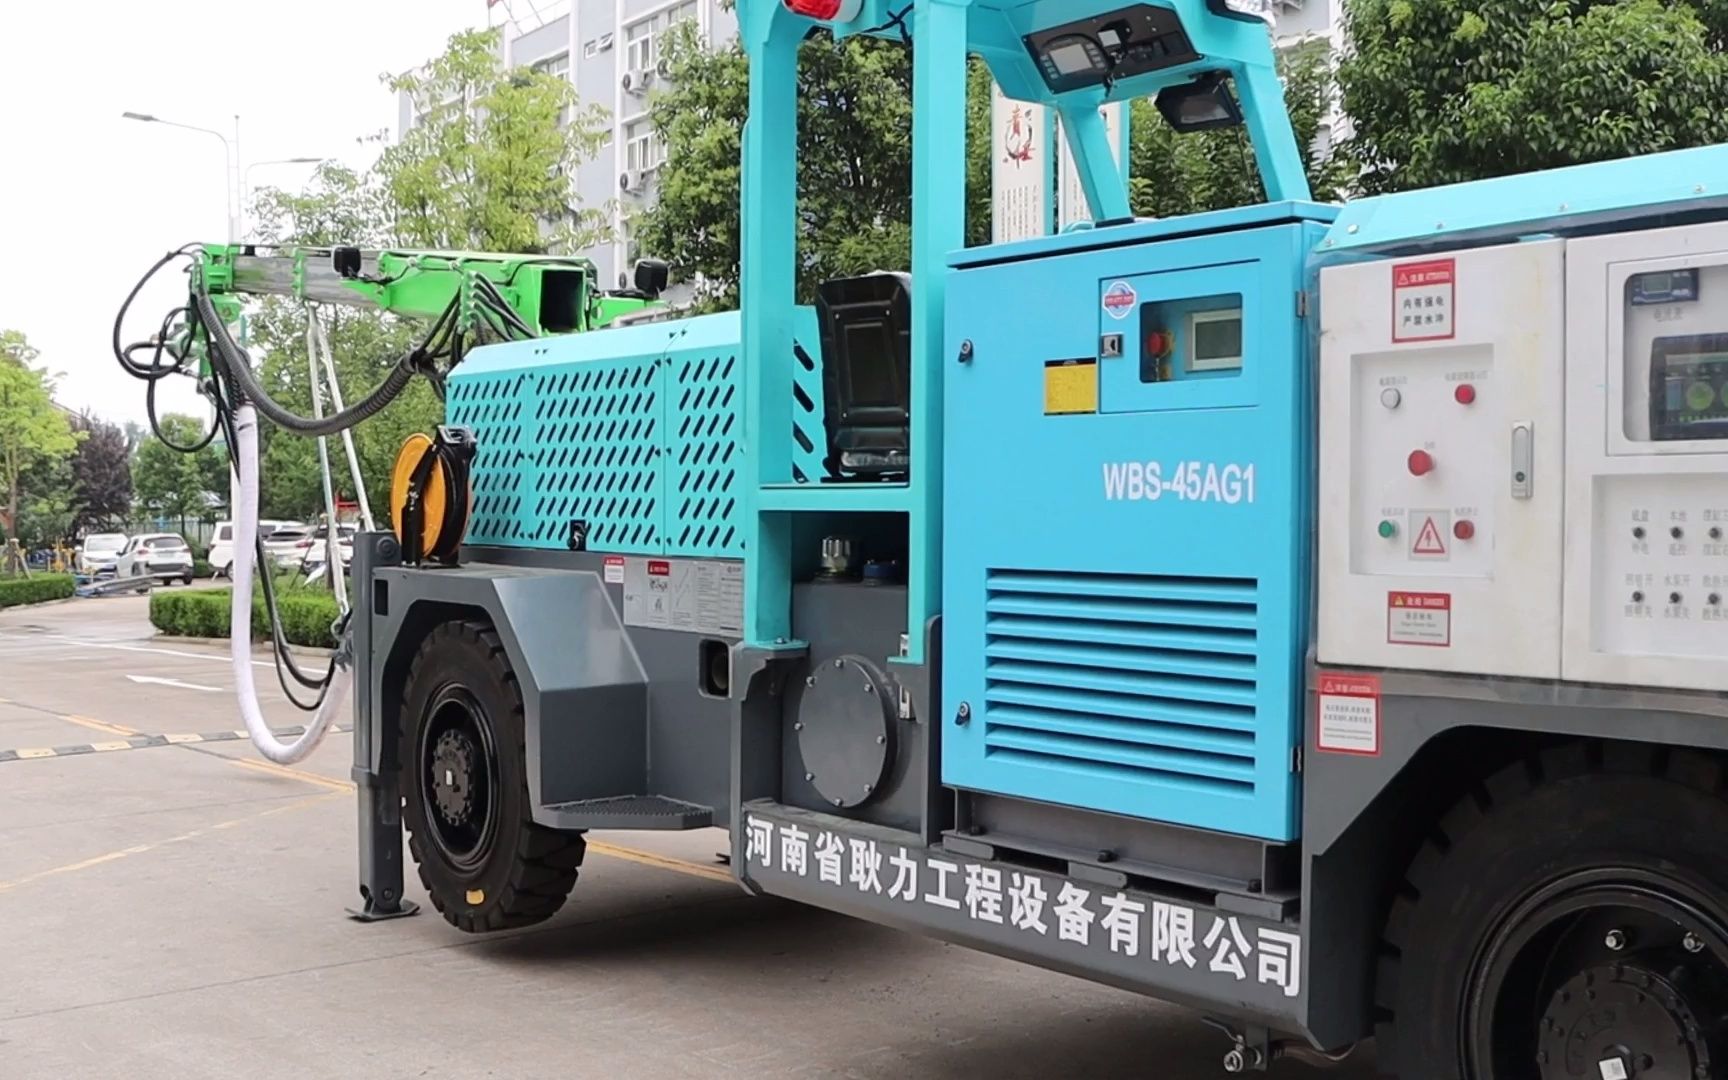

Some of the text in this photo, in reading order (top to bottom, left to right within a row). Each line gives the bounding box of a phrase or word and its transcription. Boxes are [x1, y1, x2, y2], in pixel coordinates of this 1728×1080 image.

[1103, 461, 1256, 504] WBS-45AG1
[745, 814, 1302, 997] 河南省耿力工程设备有限公司
